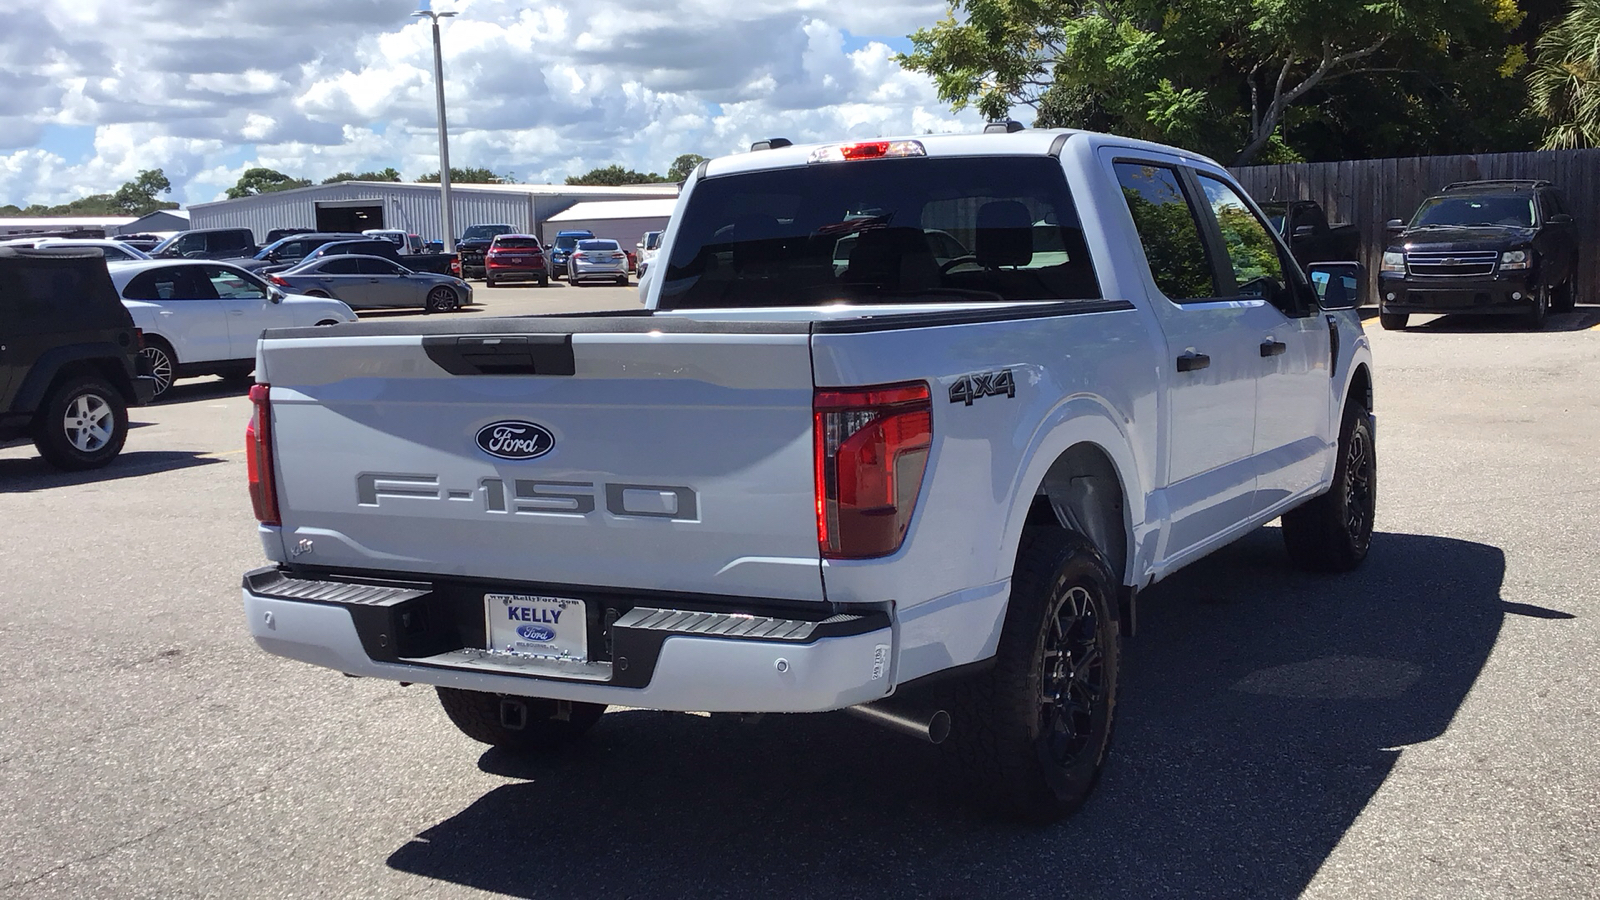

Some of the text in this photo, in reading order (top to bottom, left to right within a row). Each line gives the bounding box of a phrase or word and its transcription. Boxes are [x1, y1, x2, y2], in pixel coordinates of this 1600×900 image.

[488, 426, 539, 453] Ford
[356, 472, 701, 524] F-150
[489, 594, 580, 605] www.KellyFord.com
[508, 606, 562, 624] KELLY
[524, 627, 548, 640] Ford
